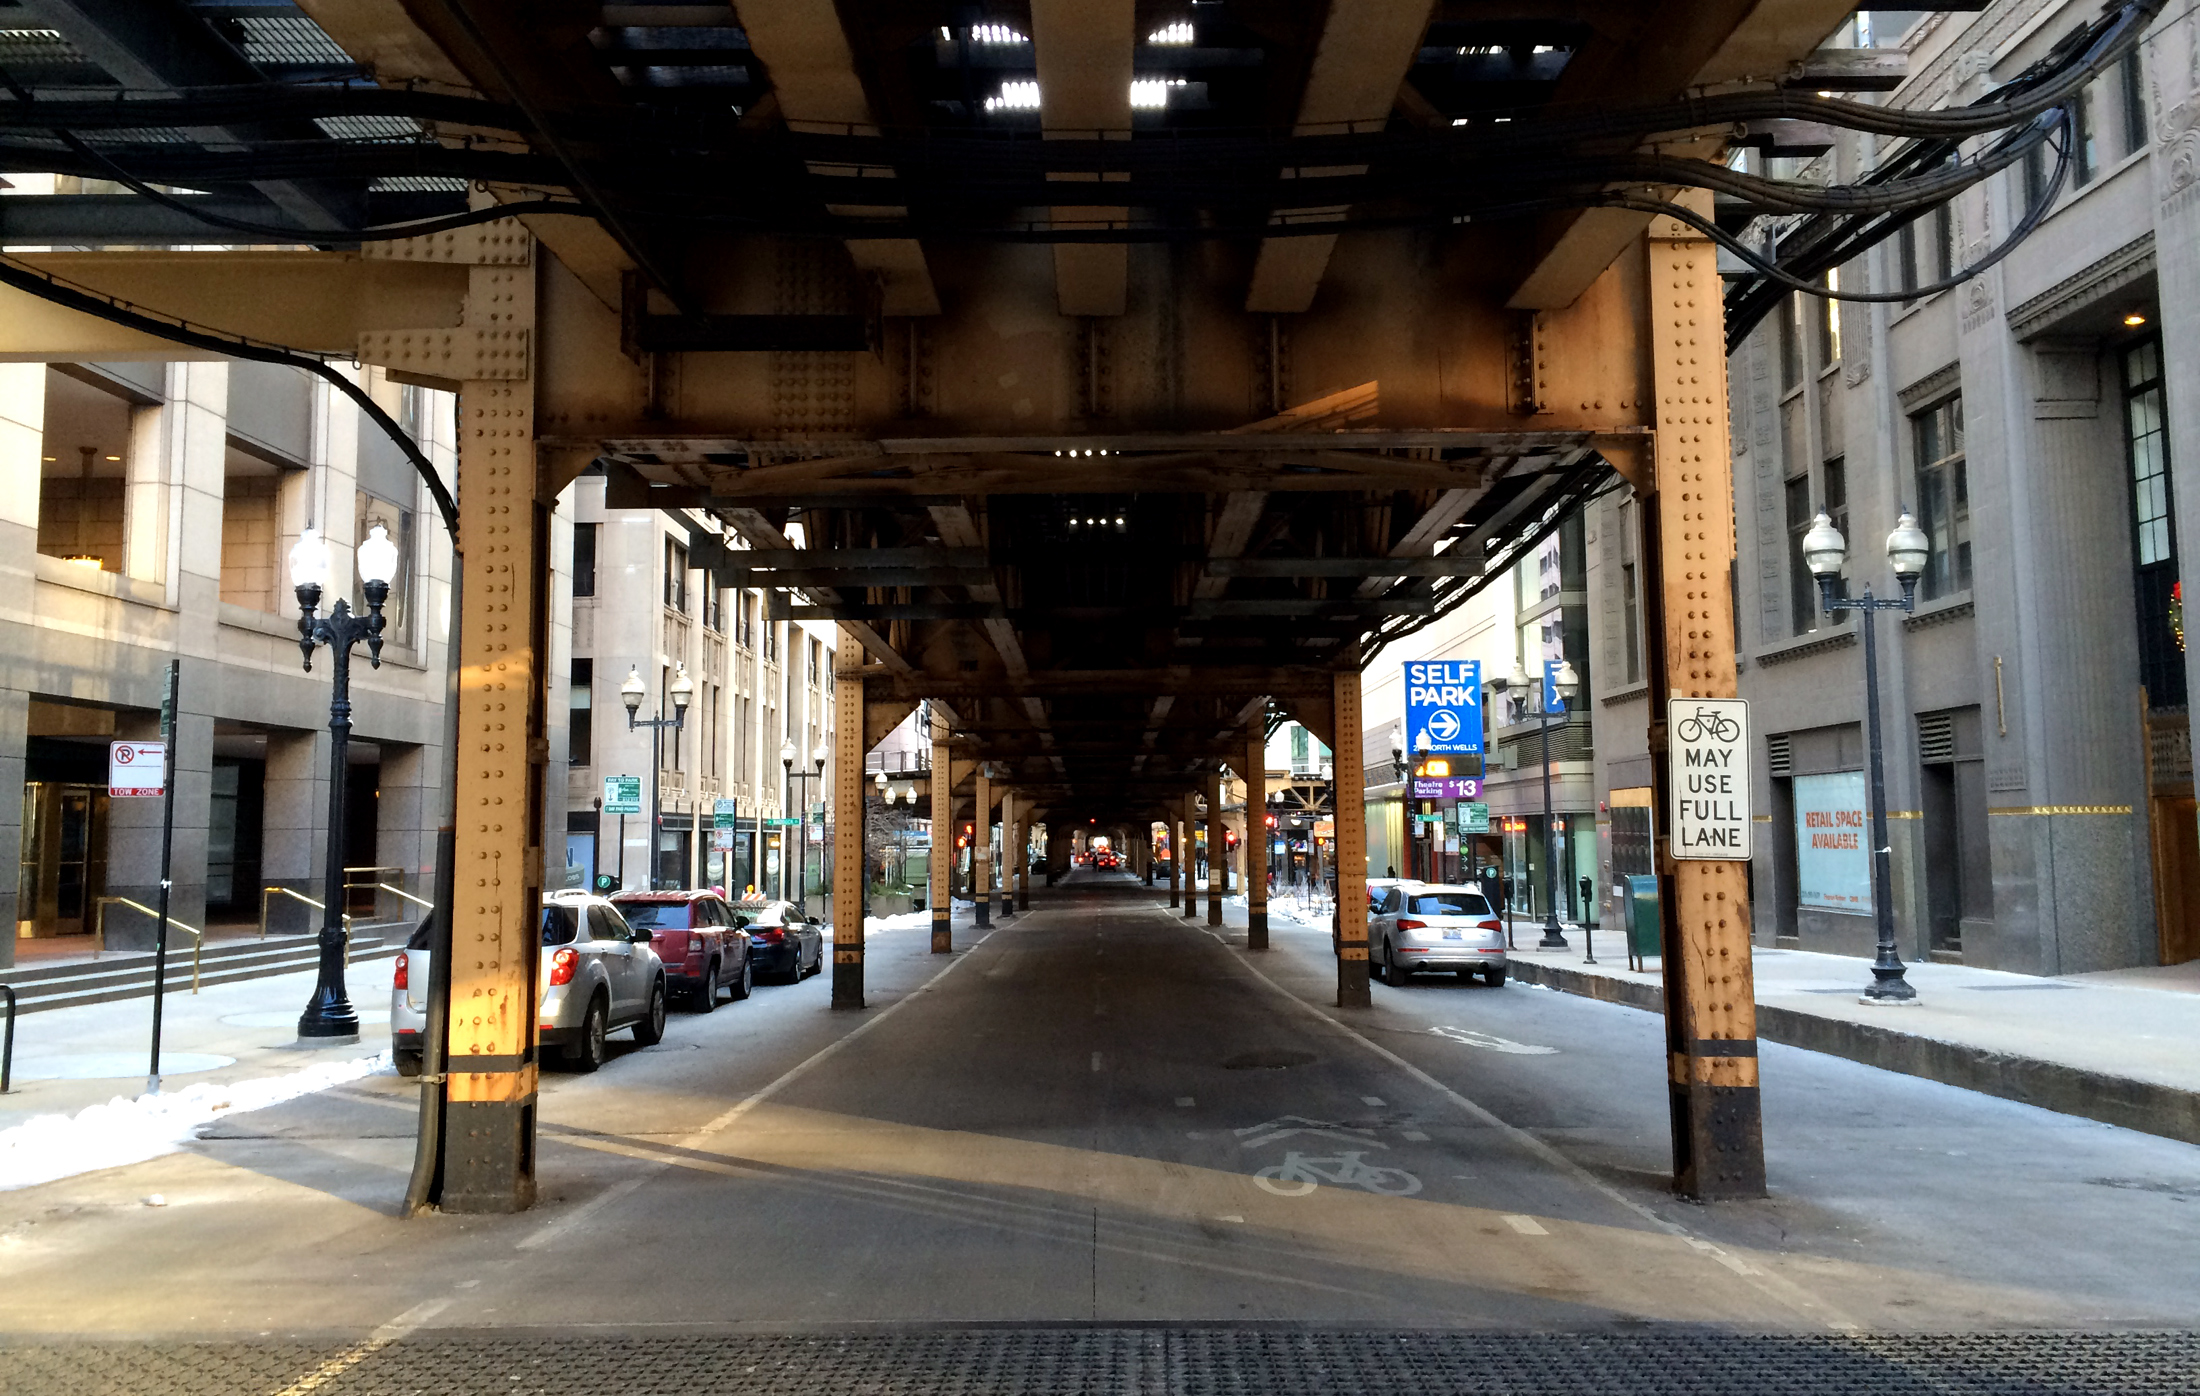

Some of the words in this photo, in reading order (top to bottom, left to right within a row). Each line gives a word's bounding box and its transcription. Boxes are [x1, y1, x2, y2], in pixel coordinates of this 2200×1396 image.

[1410, 664, 1475, 685] SELF
[1410, 686, 1476, 706] PARK
[1452, 743, 1478, 751] WELLS
[1685, 748, 1733, 767] MAY
[136, 788, 159, 796] ZONE
[1688, 774, 1733, 793] USE
[1680, 800, 1742, 821] FULL
[1806, 811, 1833, 828] RETAIL
[1835, 810, 1863, 828] SPACE
[1682, 827, 1741, 847] LANE
[1811, 832, 1859, 850] AVAILABLE
